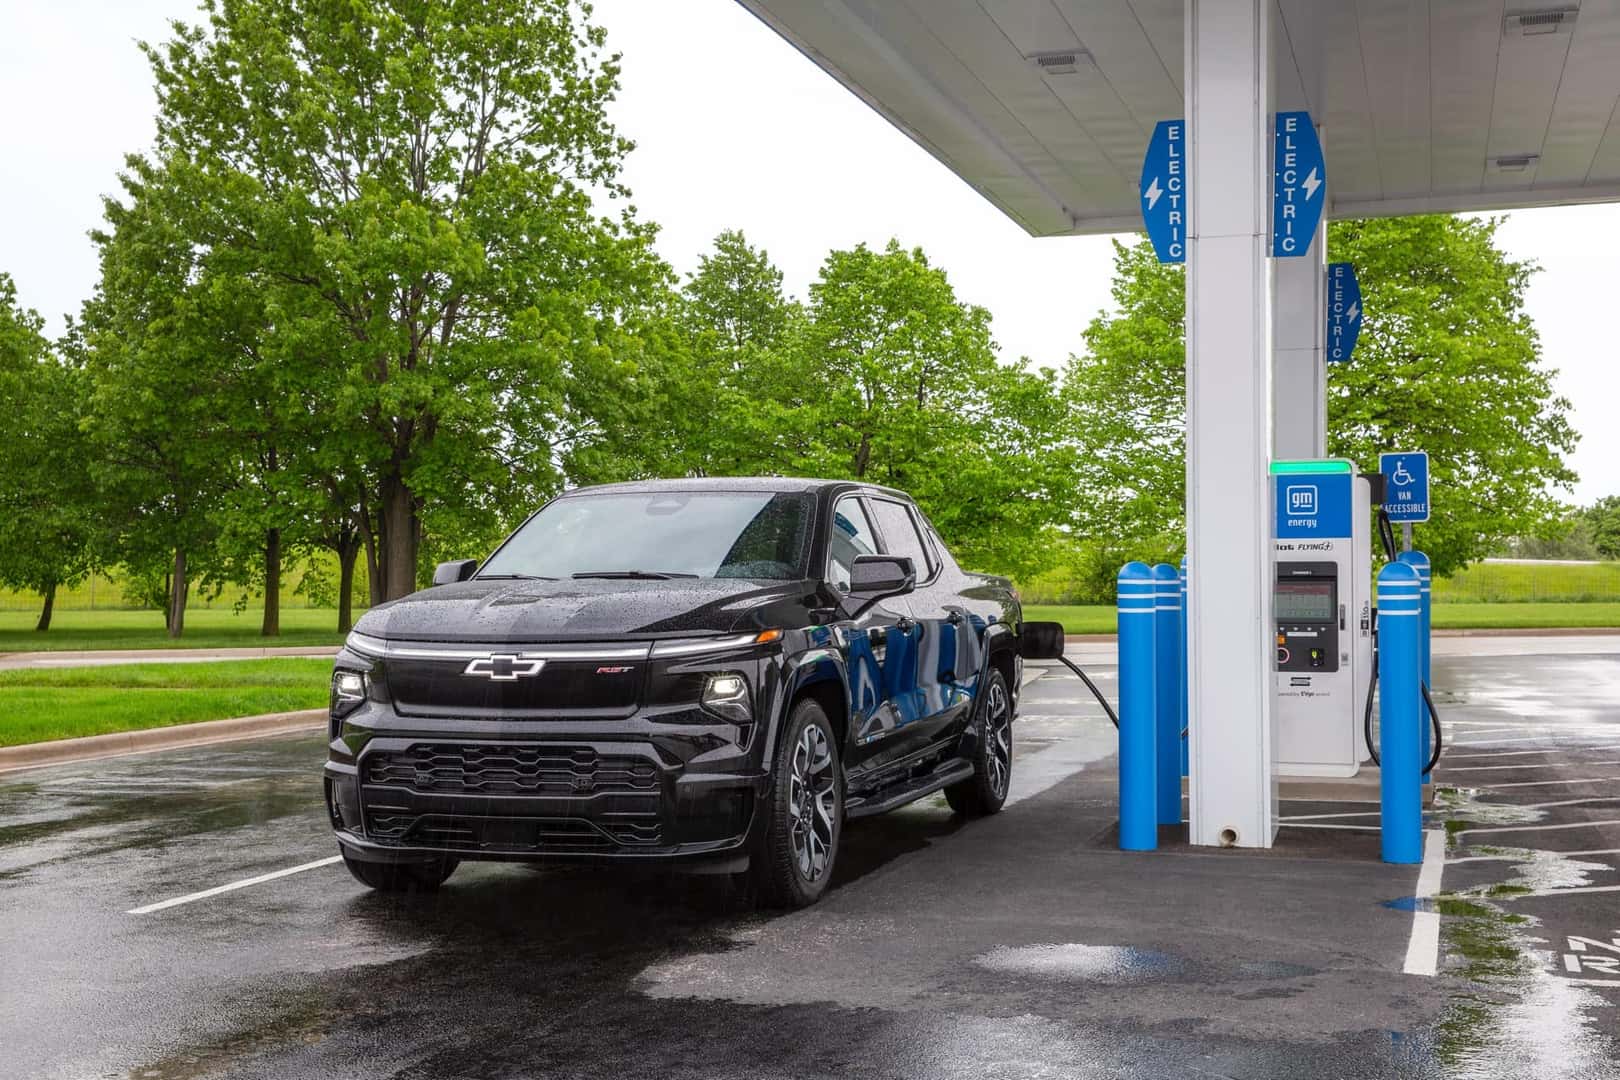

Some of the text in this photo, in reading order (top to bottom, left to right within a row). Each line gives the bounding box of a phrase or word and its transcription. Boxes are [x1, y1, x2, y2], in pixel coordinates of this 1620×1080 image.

[1281, 118, 1298, 252] ELECTRIC
[1168, 126, 1183, 258] ELECTRIC
[1332, 267, 1344, 359] ELECTRIC
[1292, 492, 1313, 508] gm
[1397, 491, 1412, 501] VAN
[1384, 503, 1426, 513] ACCESSIBLE
[1287, 519, 1318, 529] energy
[1276, 543, 1295, 551] lot
[596, 666, 635, 674] RST
